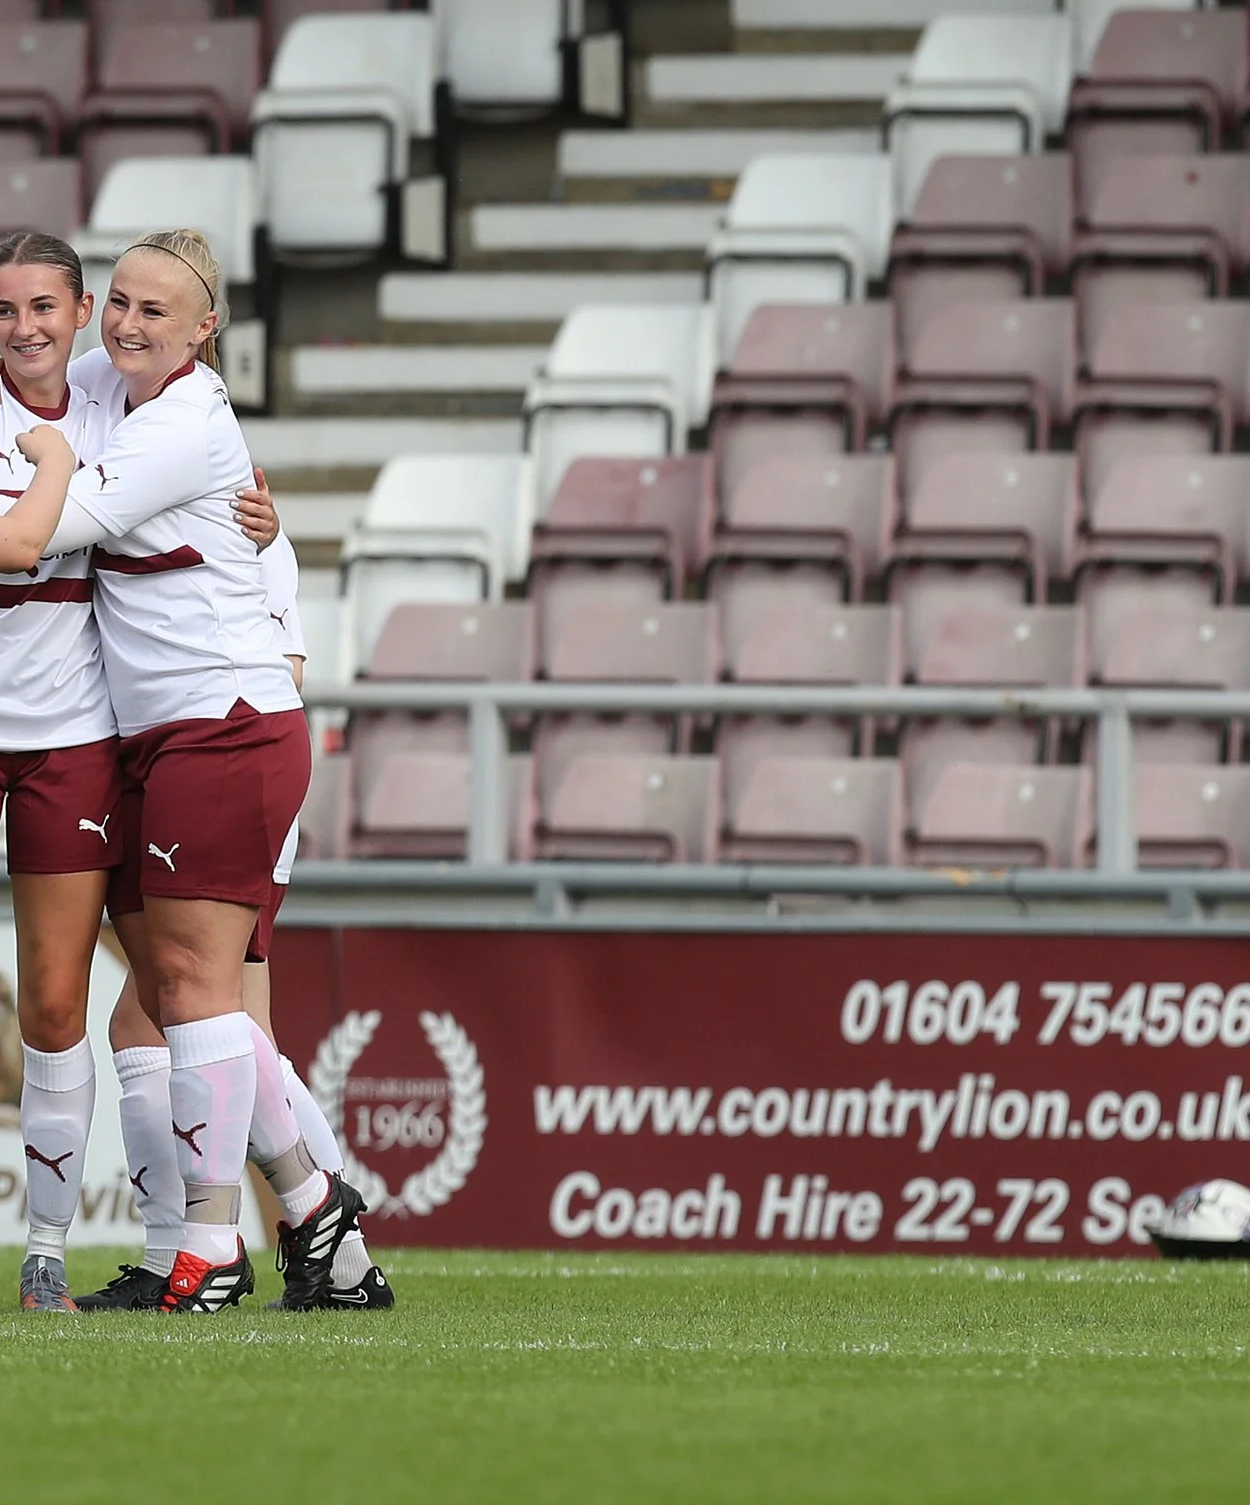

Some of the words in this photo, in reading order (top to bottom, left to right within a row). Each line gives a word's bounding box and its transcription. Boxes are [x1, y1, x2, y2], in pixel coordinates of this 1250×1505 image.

[839, 979, 1020, 1046] 01604
[1037, 981, 1250, 1047] 754566
[354, 1100, 445, 1151] 1966
[534, 1073, 1250, 1153] www.countrylion.co.uk
[550, 1170, 742, 1240] Coach
[755, 1173, 884, 1243] Hire
[894, 1178, 1070, 1243] 22-72
